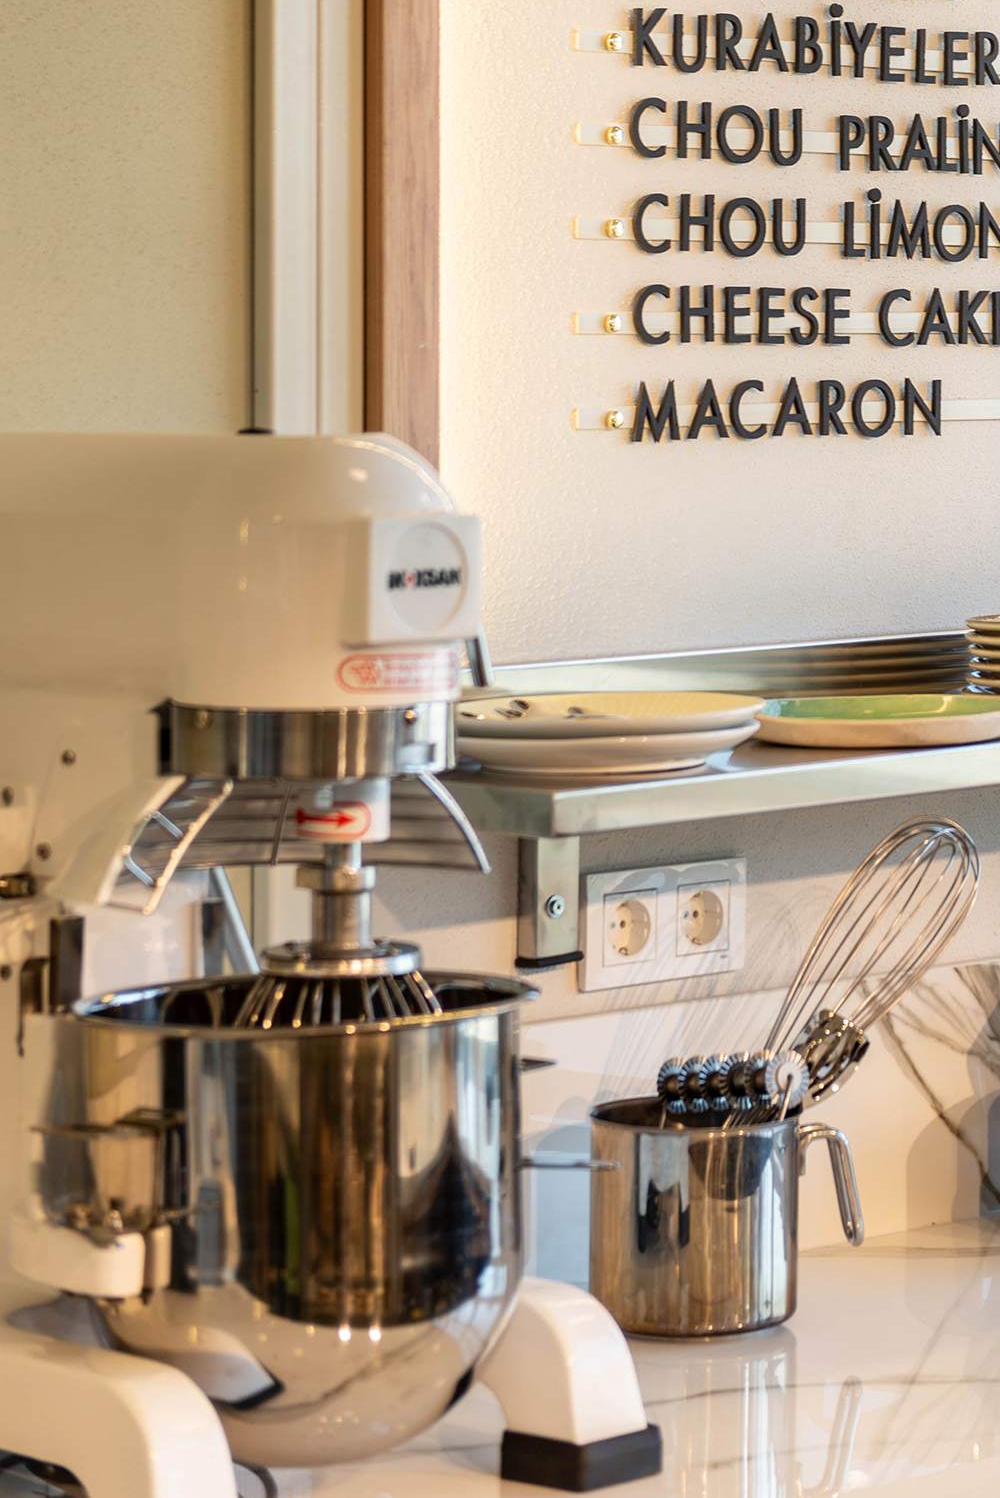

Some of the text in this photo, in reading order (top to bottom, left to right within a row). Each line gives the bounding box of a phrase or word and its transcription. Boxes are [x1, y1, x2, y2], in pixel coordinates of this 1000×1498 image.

[629, 97, 803, 166] CHOU
[632, 193, 806, 258] CHOU
[632, 284, 851, 345] CHEESE
[630, 377, 942, 442] MACARON
